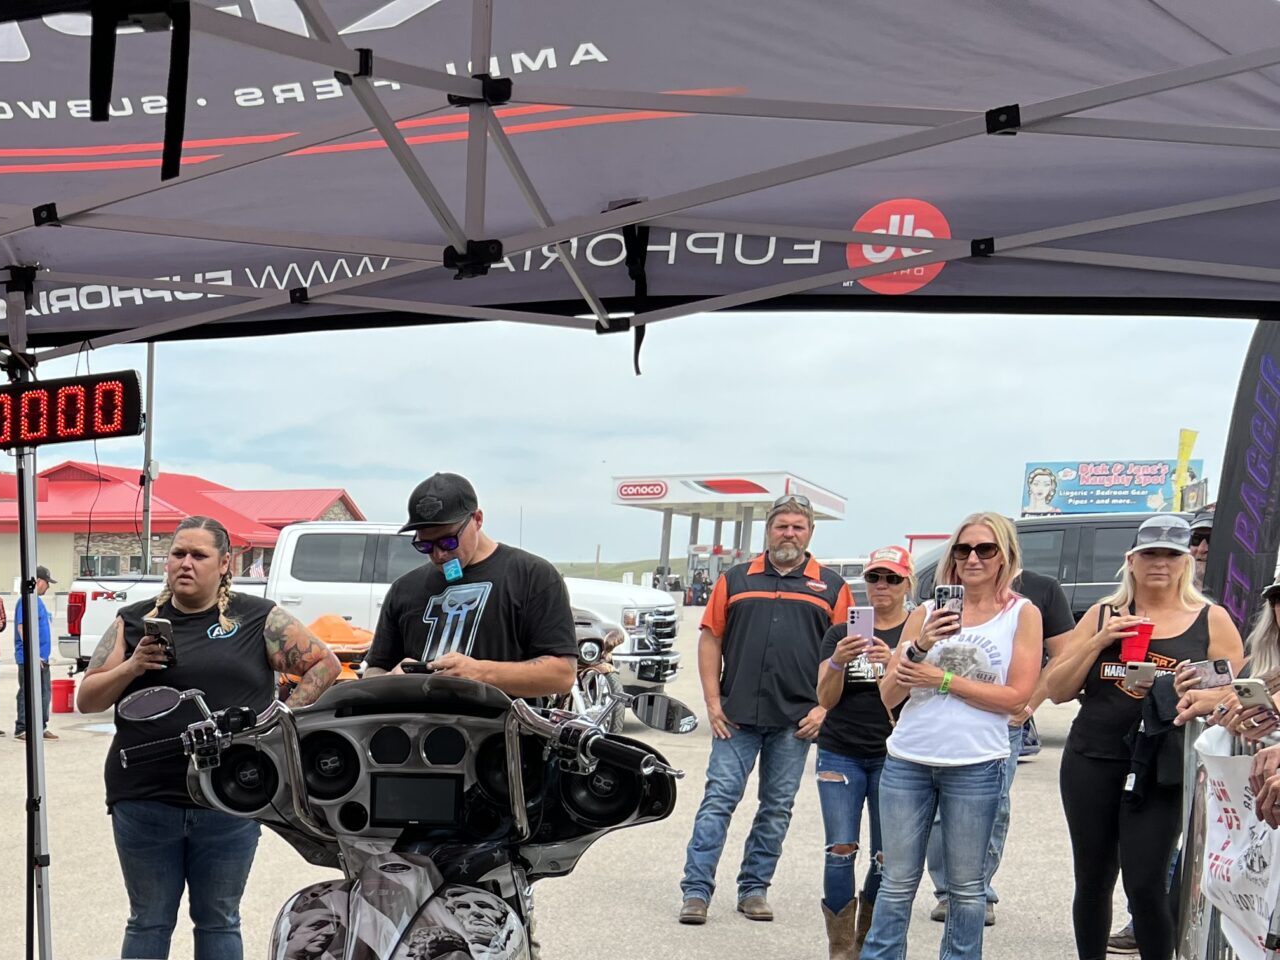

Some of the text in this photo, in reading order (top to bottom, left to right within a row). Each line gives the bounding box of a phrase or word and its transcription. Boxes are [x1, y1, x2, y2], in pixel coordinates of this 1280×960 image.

[1078, 463, 1110, 476] Dick
[1127, 462, 1169, 475] Jane's
[1079, 473, 1166, 488] Naughty Spot
[620, 484, 662, 495] conoco
[91, 591, 127, 601] FX4
